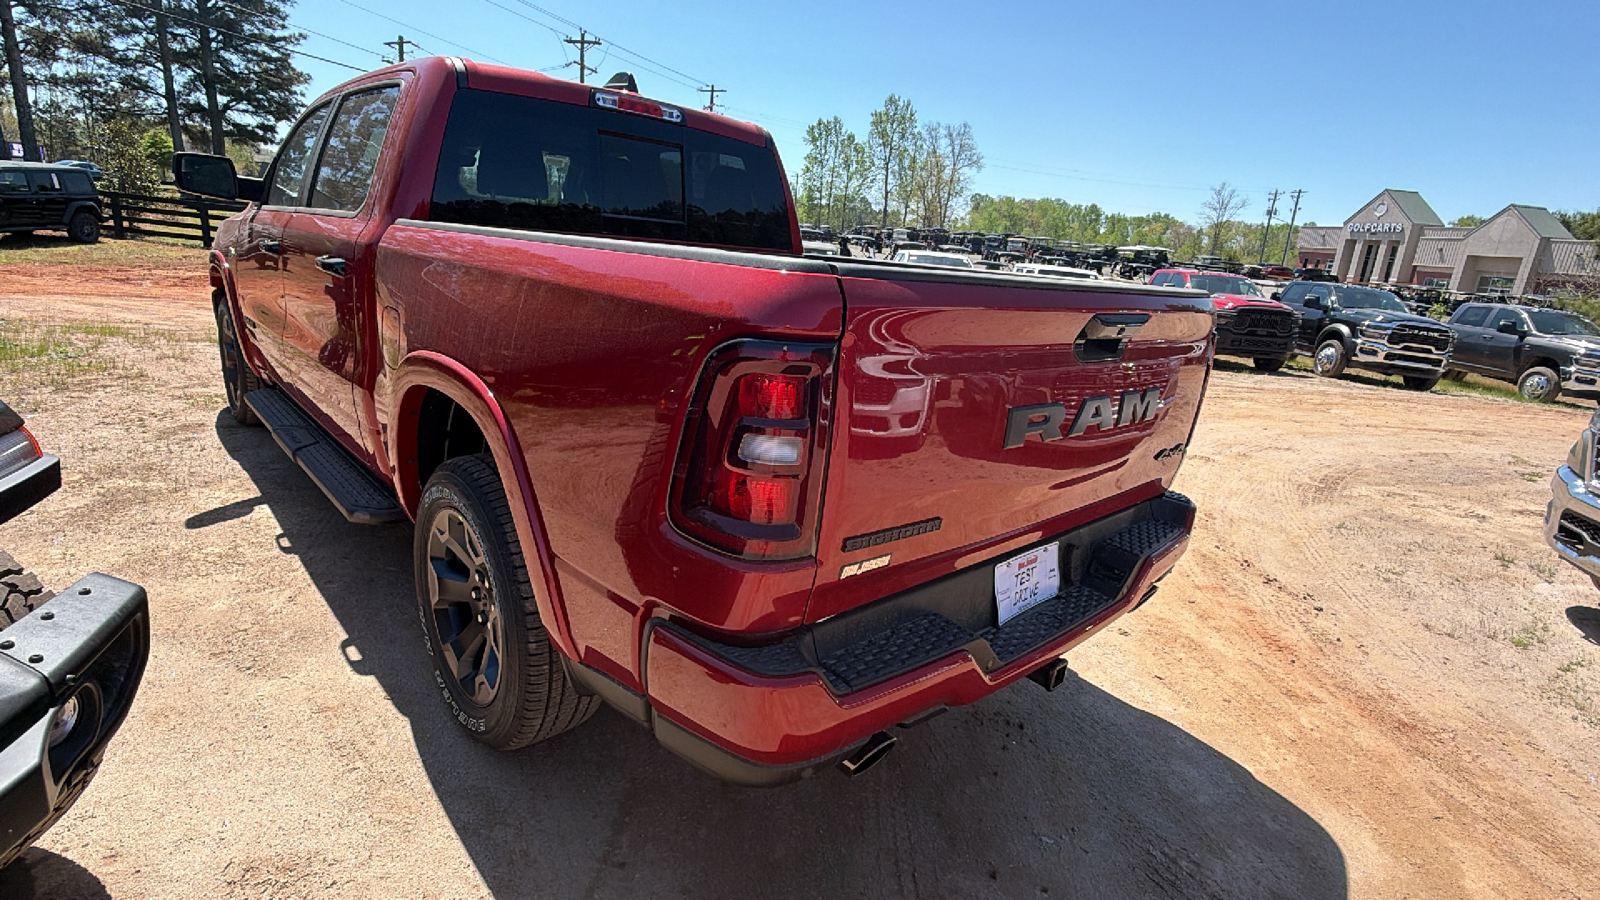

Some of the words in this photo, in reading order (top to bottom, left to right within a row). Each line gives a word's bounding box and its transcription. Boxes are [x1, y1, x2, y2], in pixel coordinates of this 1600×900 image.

[1002, 386, 1161, 450] RAM
[1014, 565, 1038, 588] TEST
[1013, 581, 1040, 607] DRIVE
